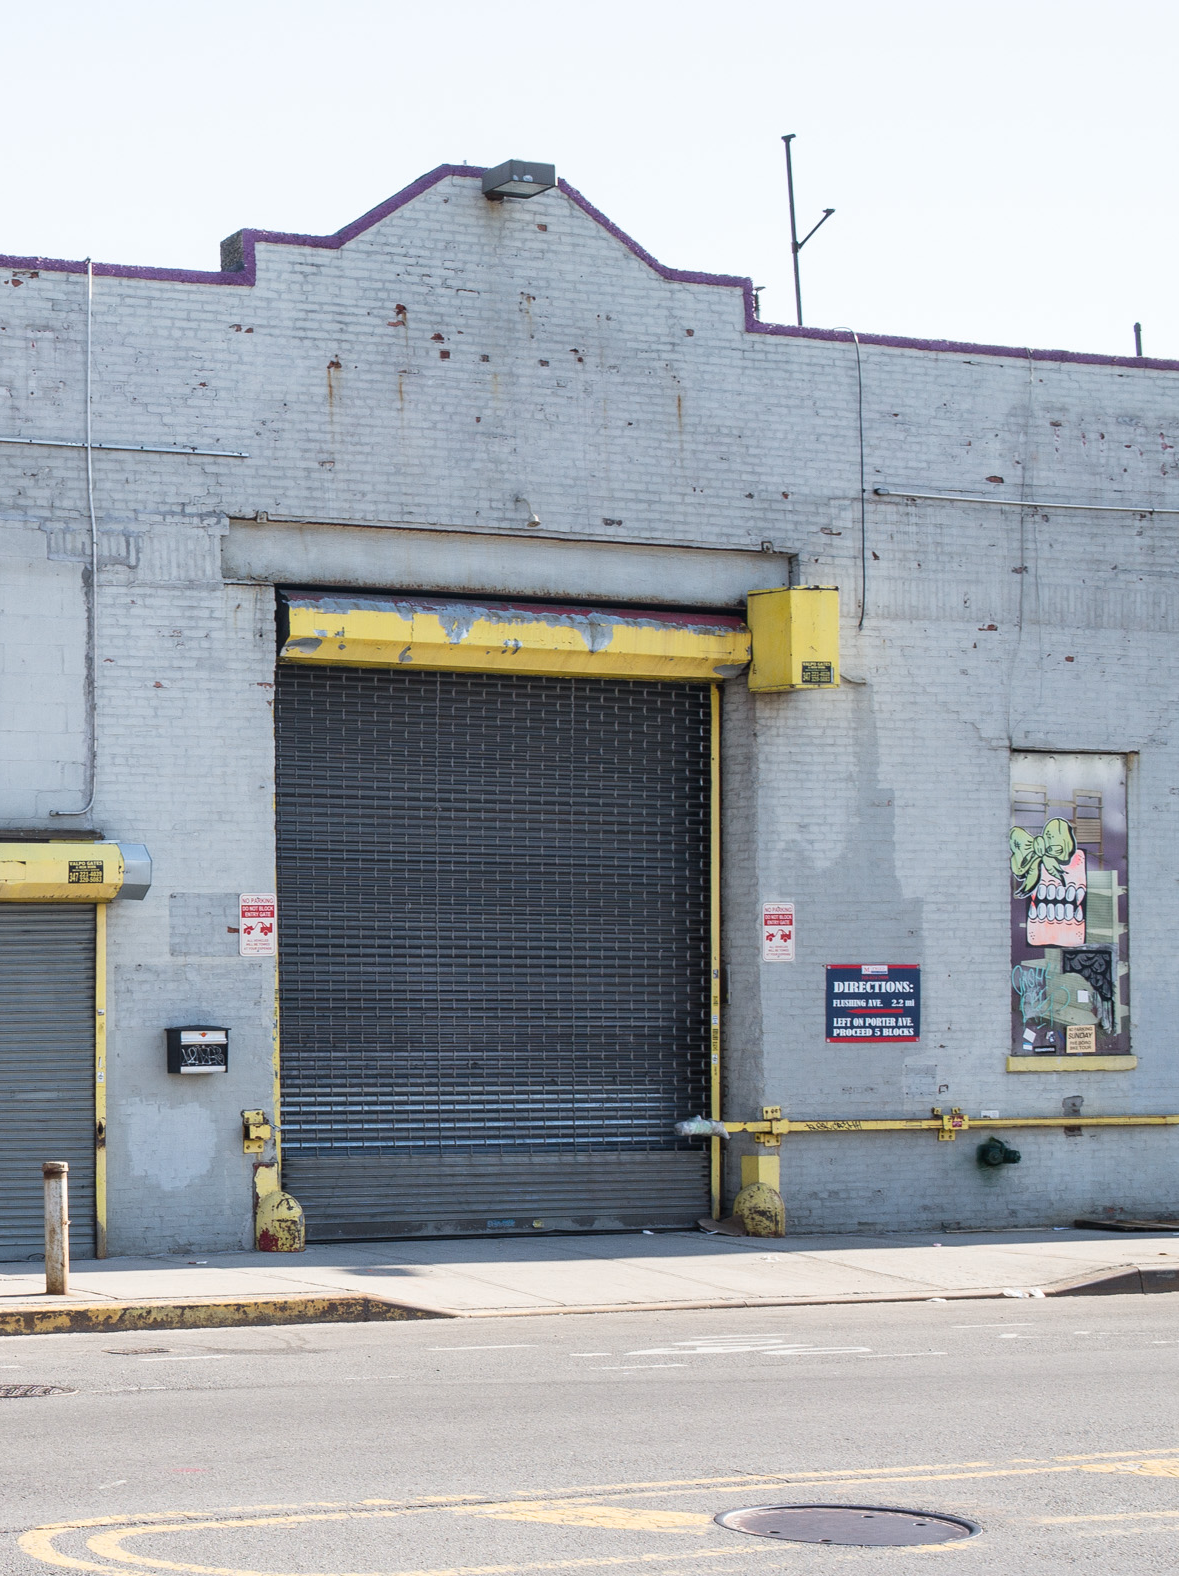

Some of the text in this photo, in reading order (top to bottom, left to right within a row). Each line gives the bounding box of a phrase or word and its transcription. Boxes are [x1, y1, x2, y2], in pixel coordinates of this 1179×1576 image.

[833, 981, 914, 993] DIRECTIONS:
[833, 999, 866, 1007] FLUSHING
[867, 999, 884, 1007] AVE.
[891, 999, 904, 1007] 2.2
[833, 1017, 914, 1026] LEFT ON PORTER AVE.
[833, 1028, 914, 1036] PROCEED 5 BLOCKS
